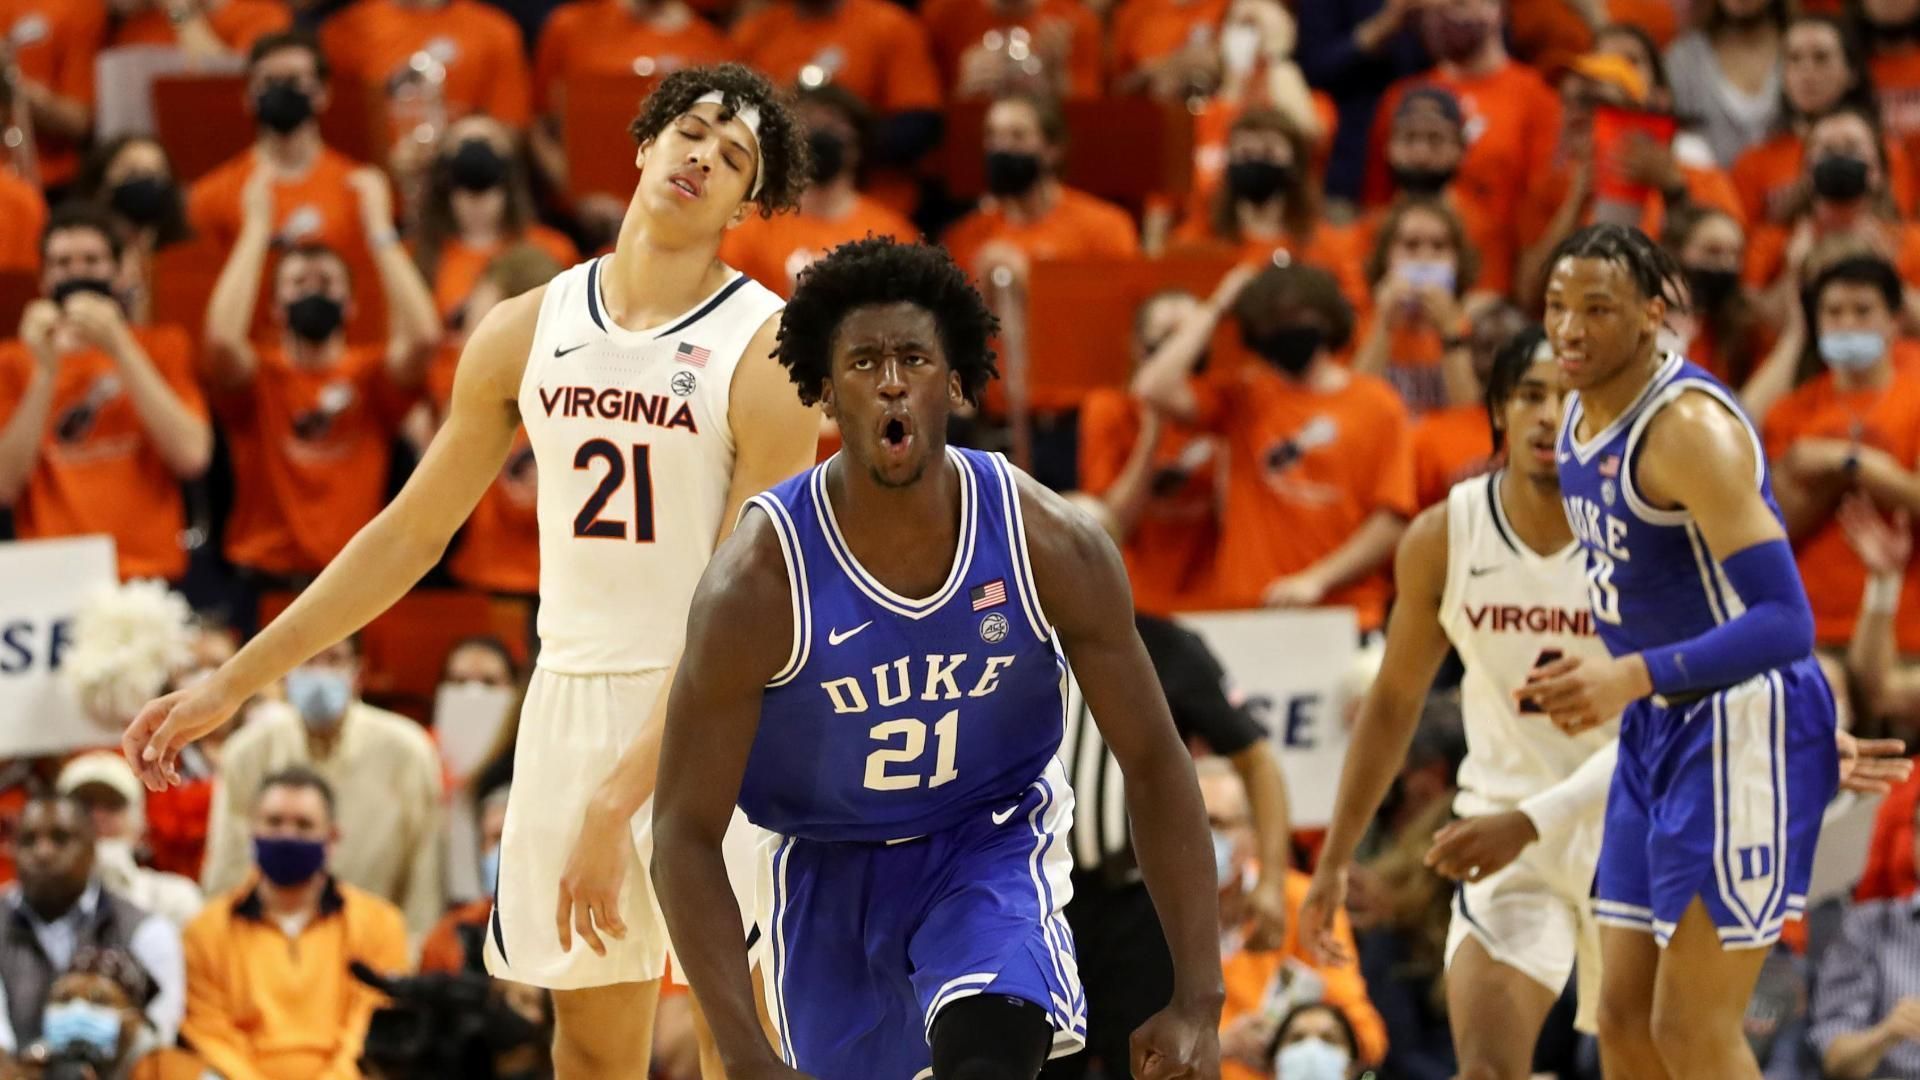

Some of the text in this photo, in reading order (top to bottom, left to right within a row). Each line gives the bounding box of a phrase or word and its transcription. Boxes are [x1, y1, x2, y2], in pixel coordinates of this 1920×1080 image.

[539, 386, 699, 434] VIRGINIA
[573, 437, 656, 543] 21
[1464, 605, 1598, 637] VIRGINI
[820, 653, 1016, 714] DUKE
[863, 709, 959, 791] 21
[1738, 844, 1770, 881] D
